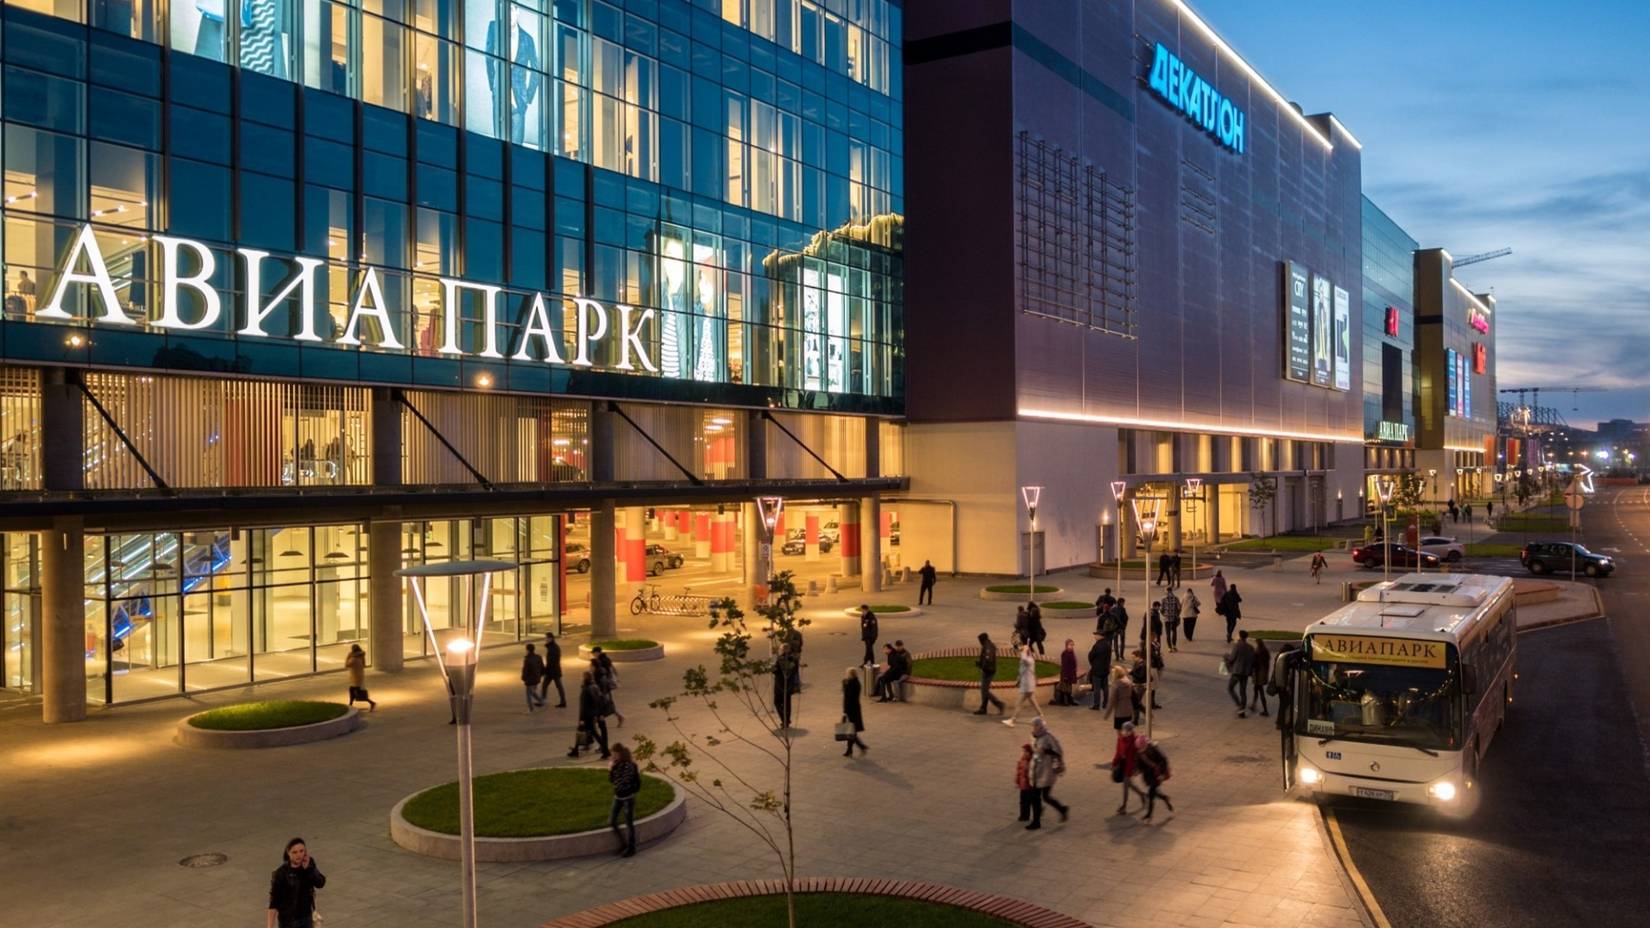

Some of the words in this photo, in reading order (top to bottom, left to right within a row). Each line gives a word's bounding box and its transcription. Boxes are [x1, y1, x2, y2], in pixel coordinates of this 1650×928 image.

[1150, 42, 1243, 154] ДЕКАТЛОН
[36, 223, 659, 372] АВИАПАРК
[1324, 639, 1437, 658] АВИАПАРК
